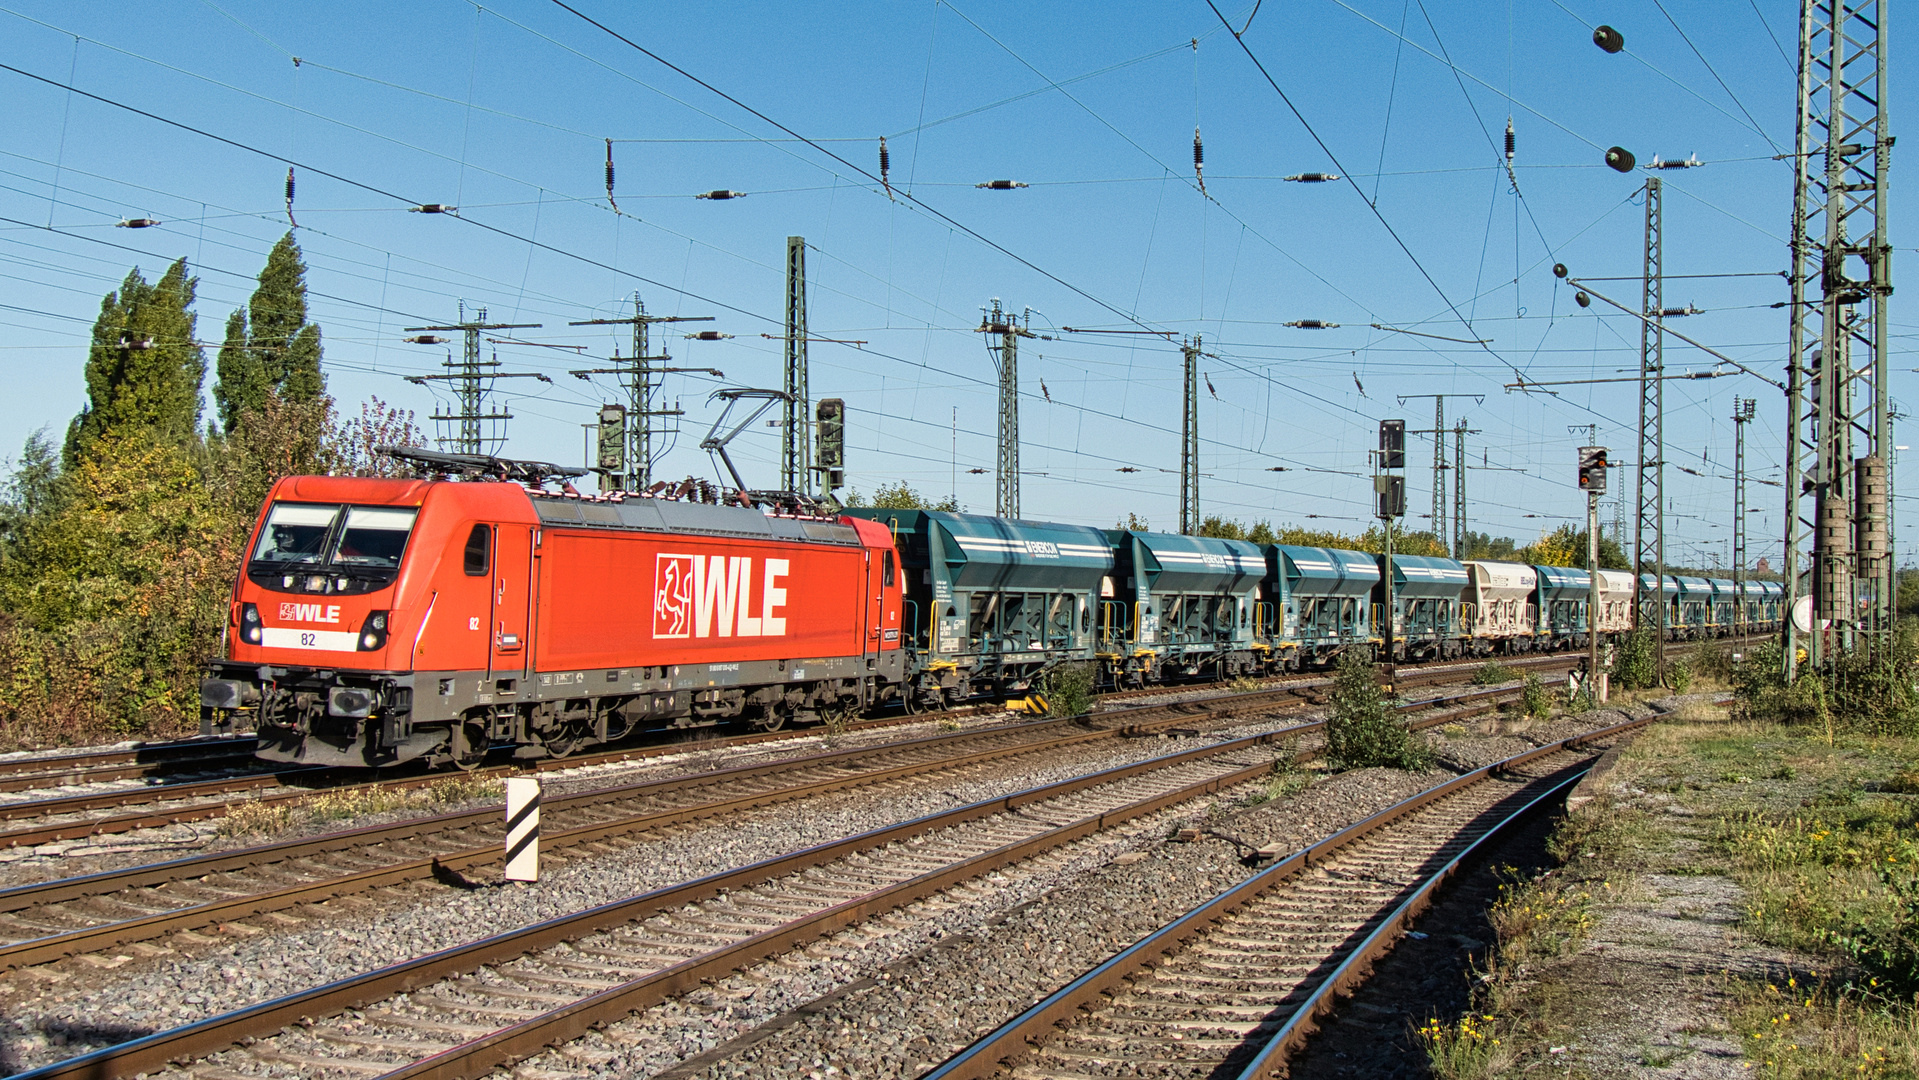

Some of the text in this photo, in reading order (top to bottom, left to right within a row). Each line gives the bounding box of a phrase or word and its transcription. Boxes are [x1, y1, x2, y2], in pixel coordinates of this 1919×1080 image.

[694, 555, 789, 638] WLE
[296, 604, 340, 623] WLE
[469, 617, 479, 630] 82
[301, 633, 316, 646] 82
[477, 680, 483, 691] 2
